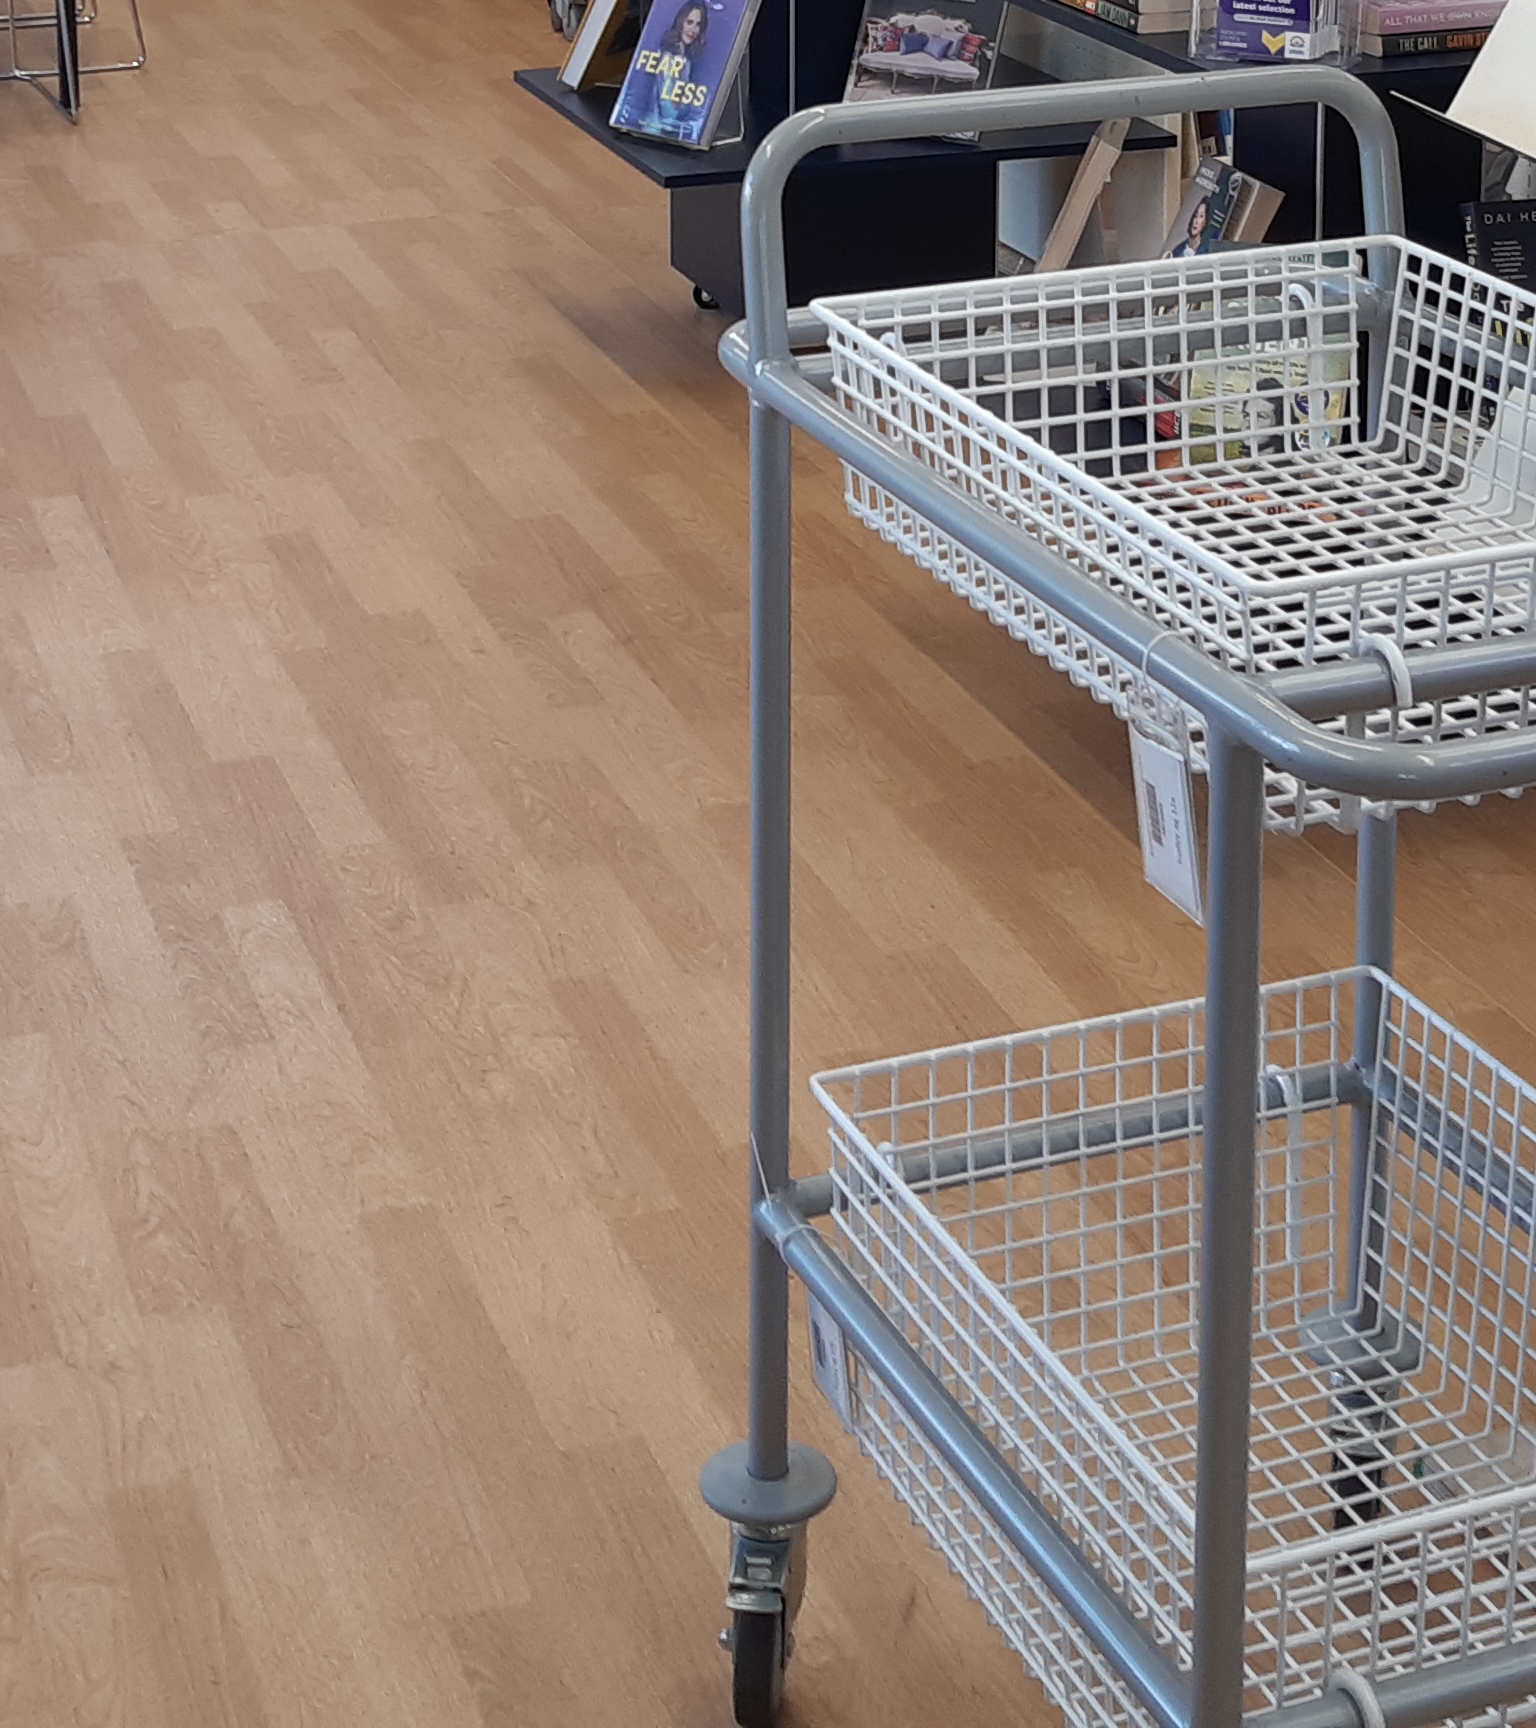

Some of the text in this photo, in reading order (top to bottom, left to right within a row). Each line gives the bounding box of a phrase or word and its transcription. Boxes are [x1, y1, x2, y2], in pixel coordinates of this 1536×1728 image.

[1231, 0, 1296, 15] latest selection
[635, 50, 686, 78] FEAR
[659, 79, 708, 107] LESS
[1483, 213, 1512, 225] DAI
